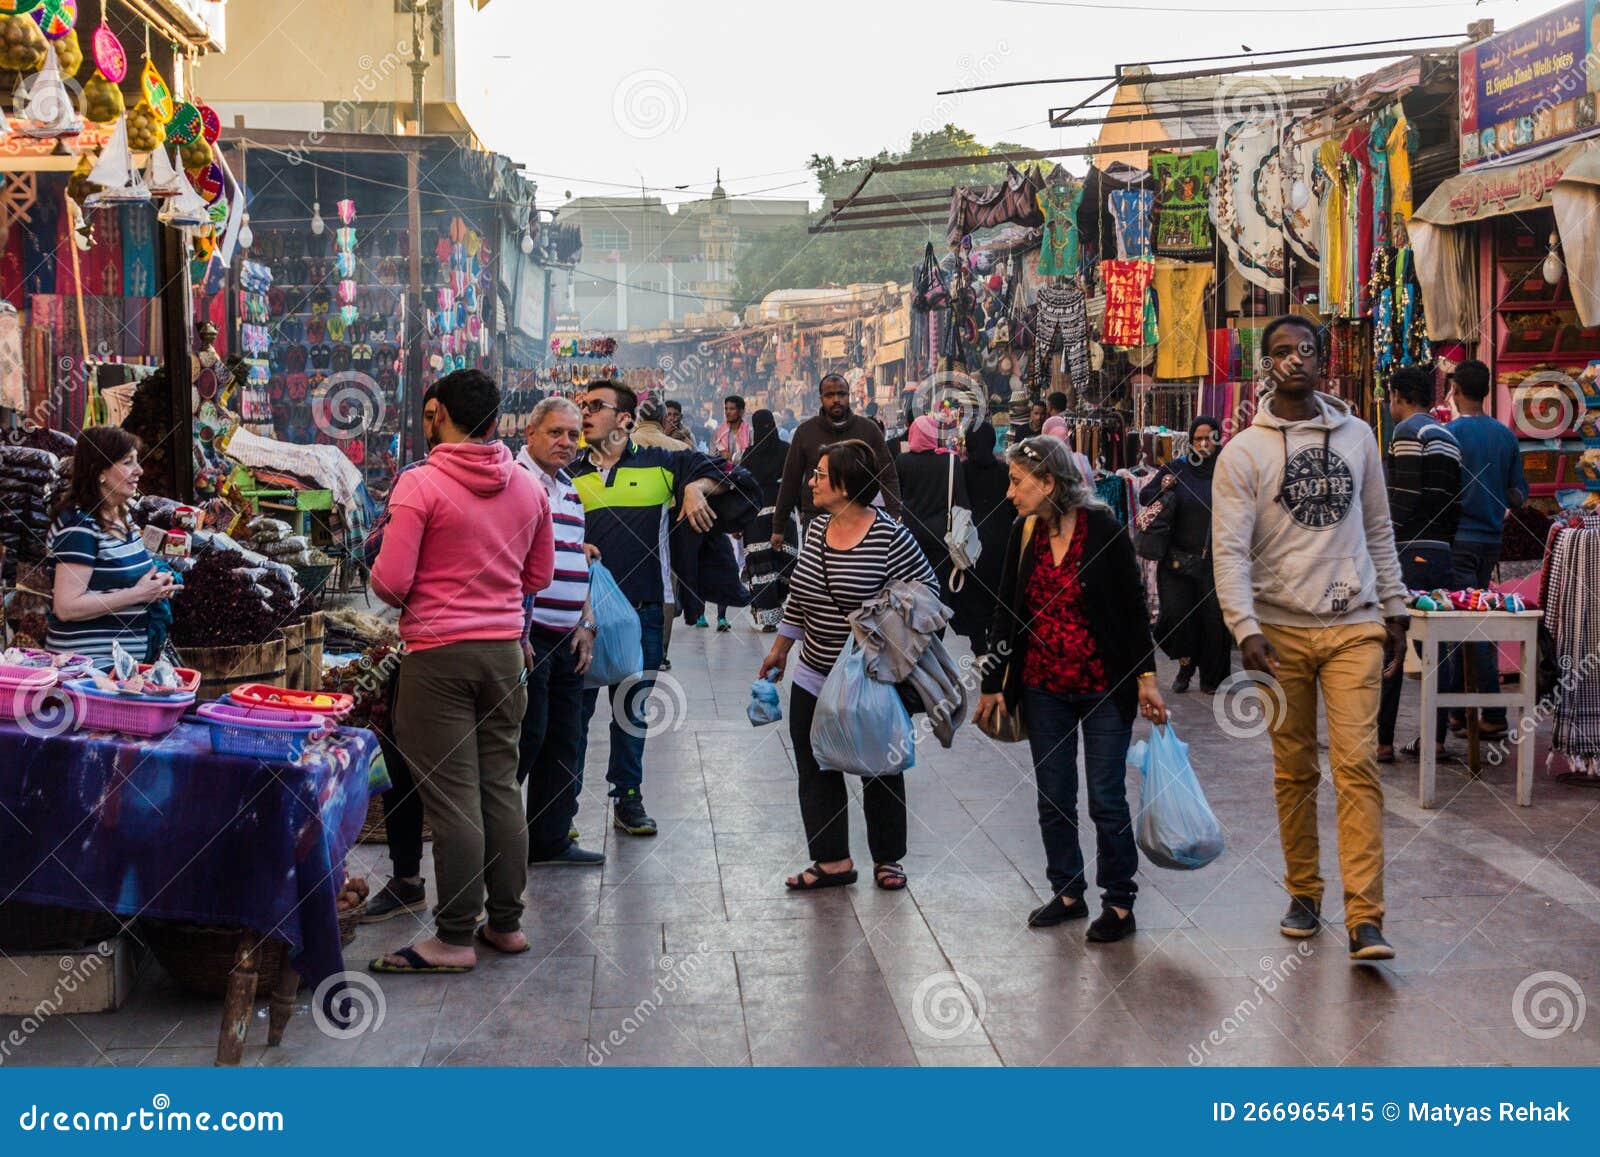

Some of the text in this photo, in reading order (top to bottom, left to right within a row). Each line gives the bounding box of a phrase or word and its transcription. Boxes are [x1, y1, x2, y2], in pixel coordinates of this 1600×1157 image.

[1480, 16, 1581, 75] عطارة السيدة زينب
[1514, 64, 1533, 85] Zinab
[1533, 56, 1552, 78] Wells
[1553, 49, 1574, 74] Spices
[1482, 168, 1527, 211] السيدة
